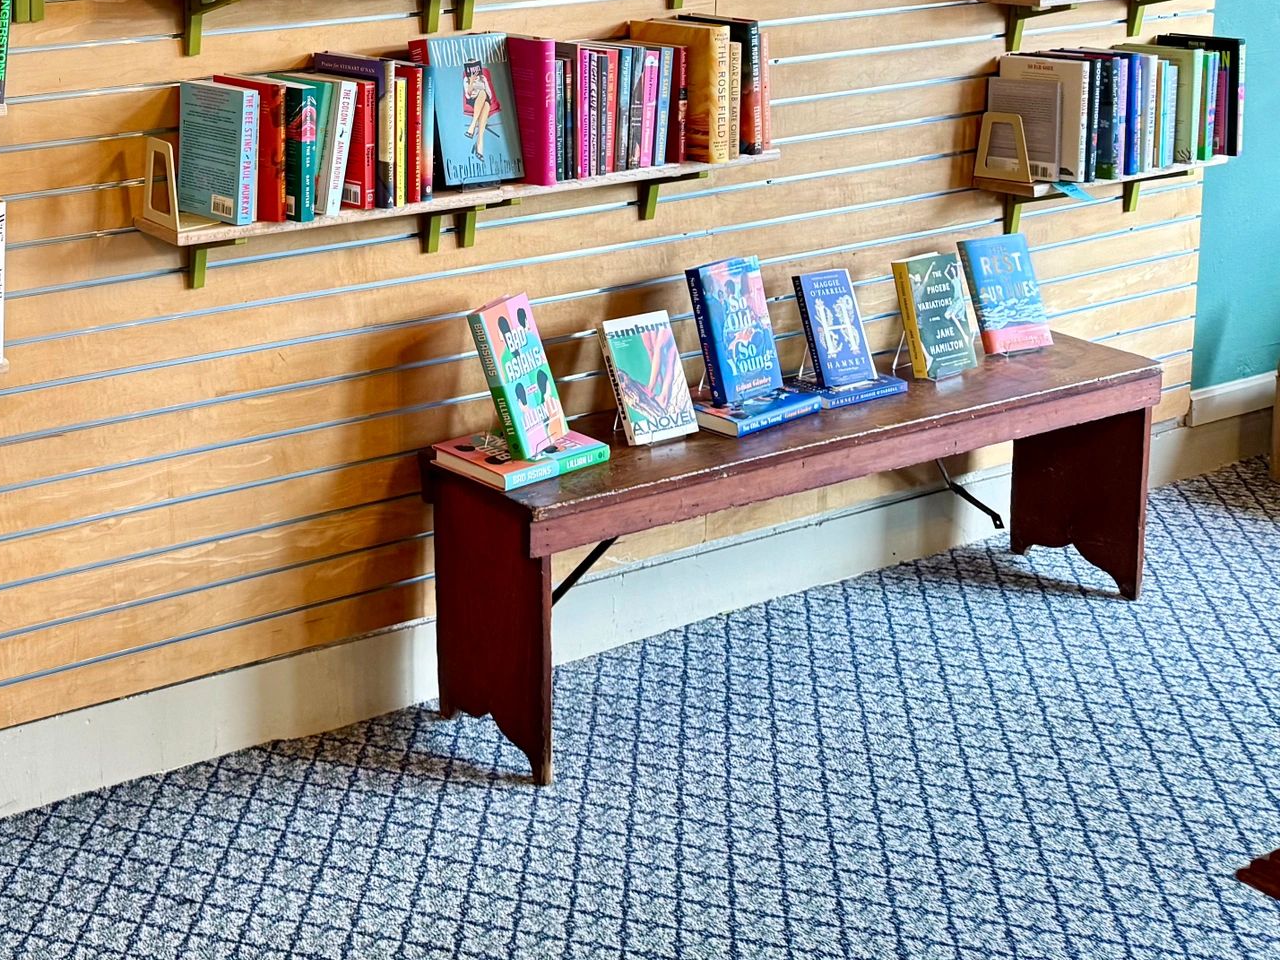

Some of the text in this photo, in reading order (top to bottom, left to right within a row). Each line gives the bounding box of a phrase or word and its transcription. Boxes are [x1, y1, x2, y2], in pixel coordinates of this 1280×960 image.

[431, 36, 508, 68] WORKHORSE
[718, 45, 726, 137] THE ROSE FIELD
[980, 252, 1021, 275] REST
[810, 286, 847, 297] O'FARRELL
[813, 280, 840, 289] MAGGIE
[927, 282, 951, 294] PHOEBE
[917, 297, 952, 312] VARIATIONS
[505, 327, 528, 353] BAD
[936, 326, 955, 339] JANE
[474, 323, 497, 376] BAD ASIANS
[738, 343, 757, 360] So
[930, 340, 964, 355] HAMILTON
[505, 349, 542, 381] ASIANS
[727, 353, 773, 376] Young
[827, 358, 866, 370] HAMNET
[497, 398, 511, 427] LILLIAN
[633, 411, 695, 433] A NOVEL
[512, 466, 551, 484] BAD ASIANS
